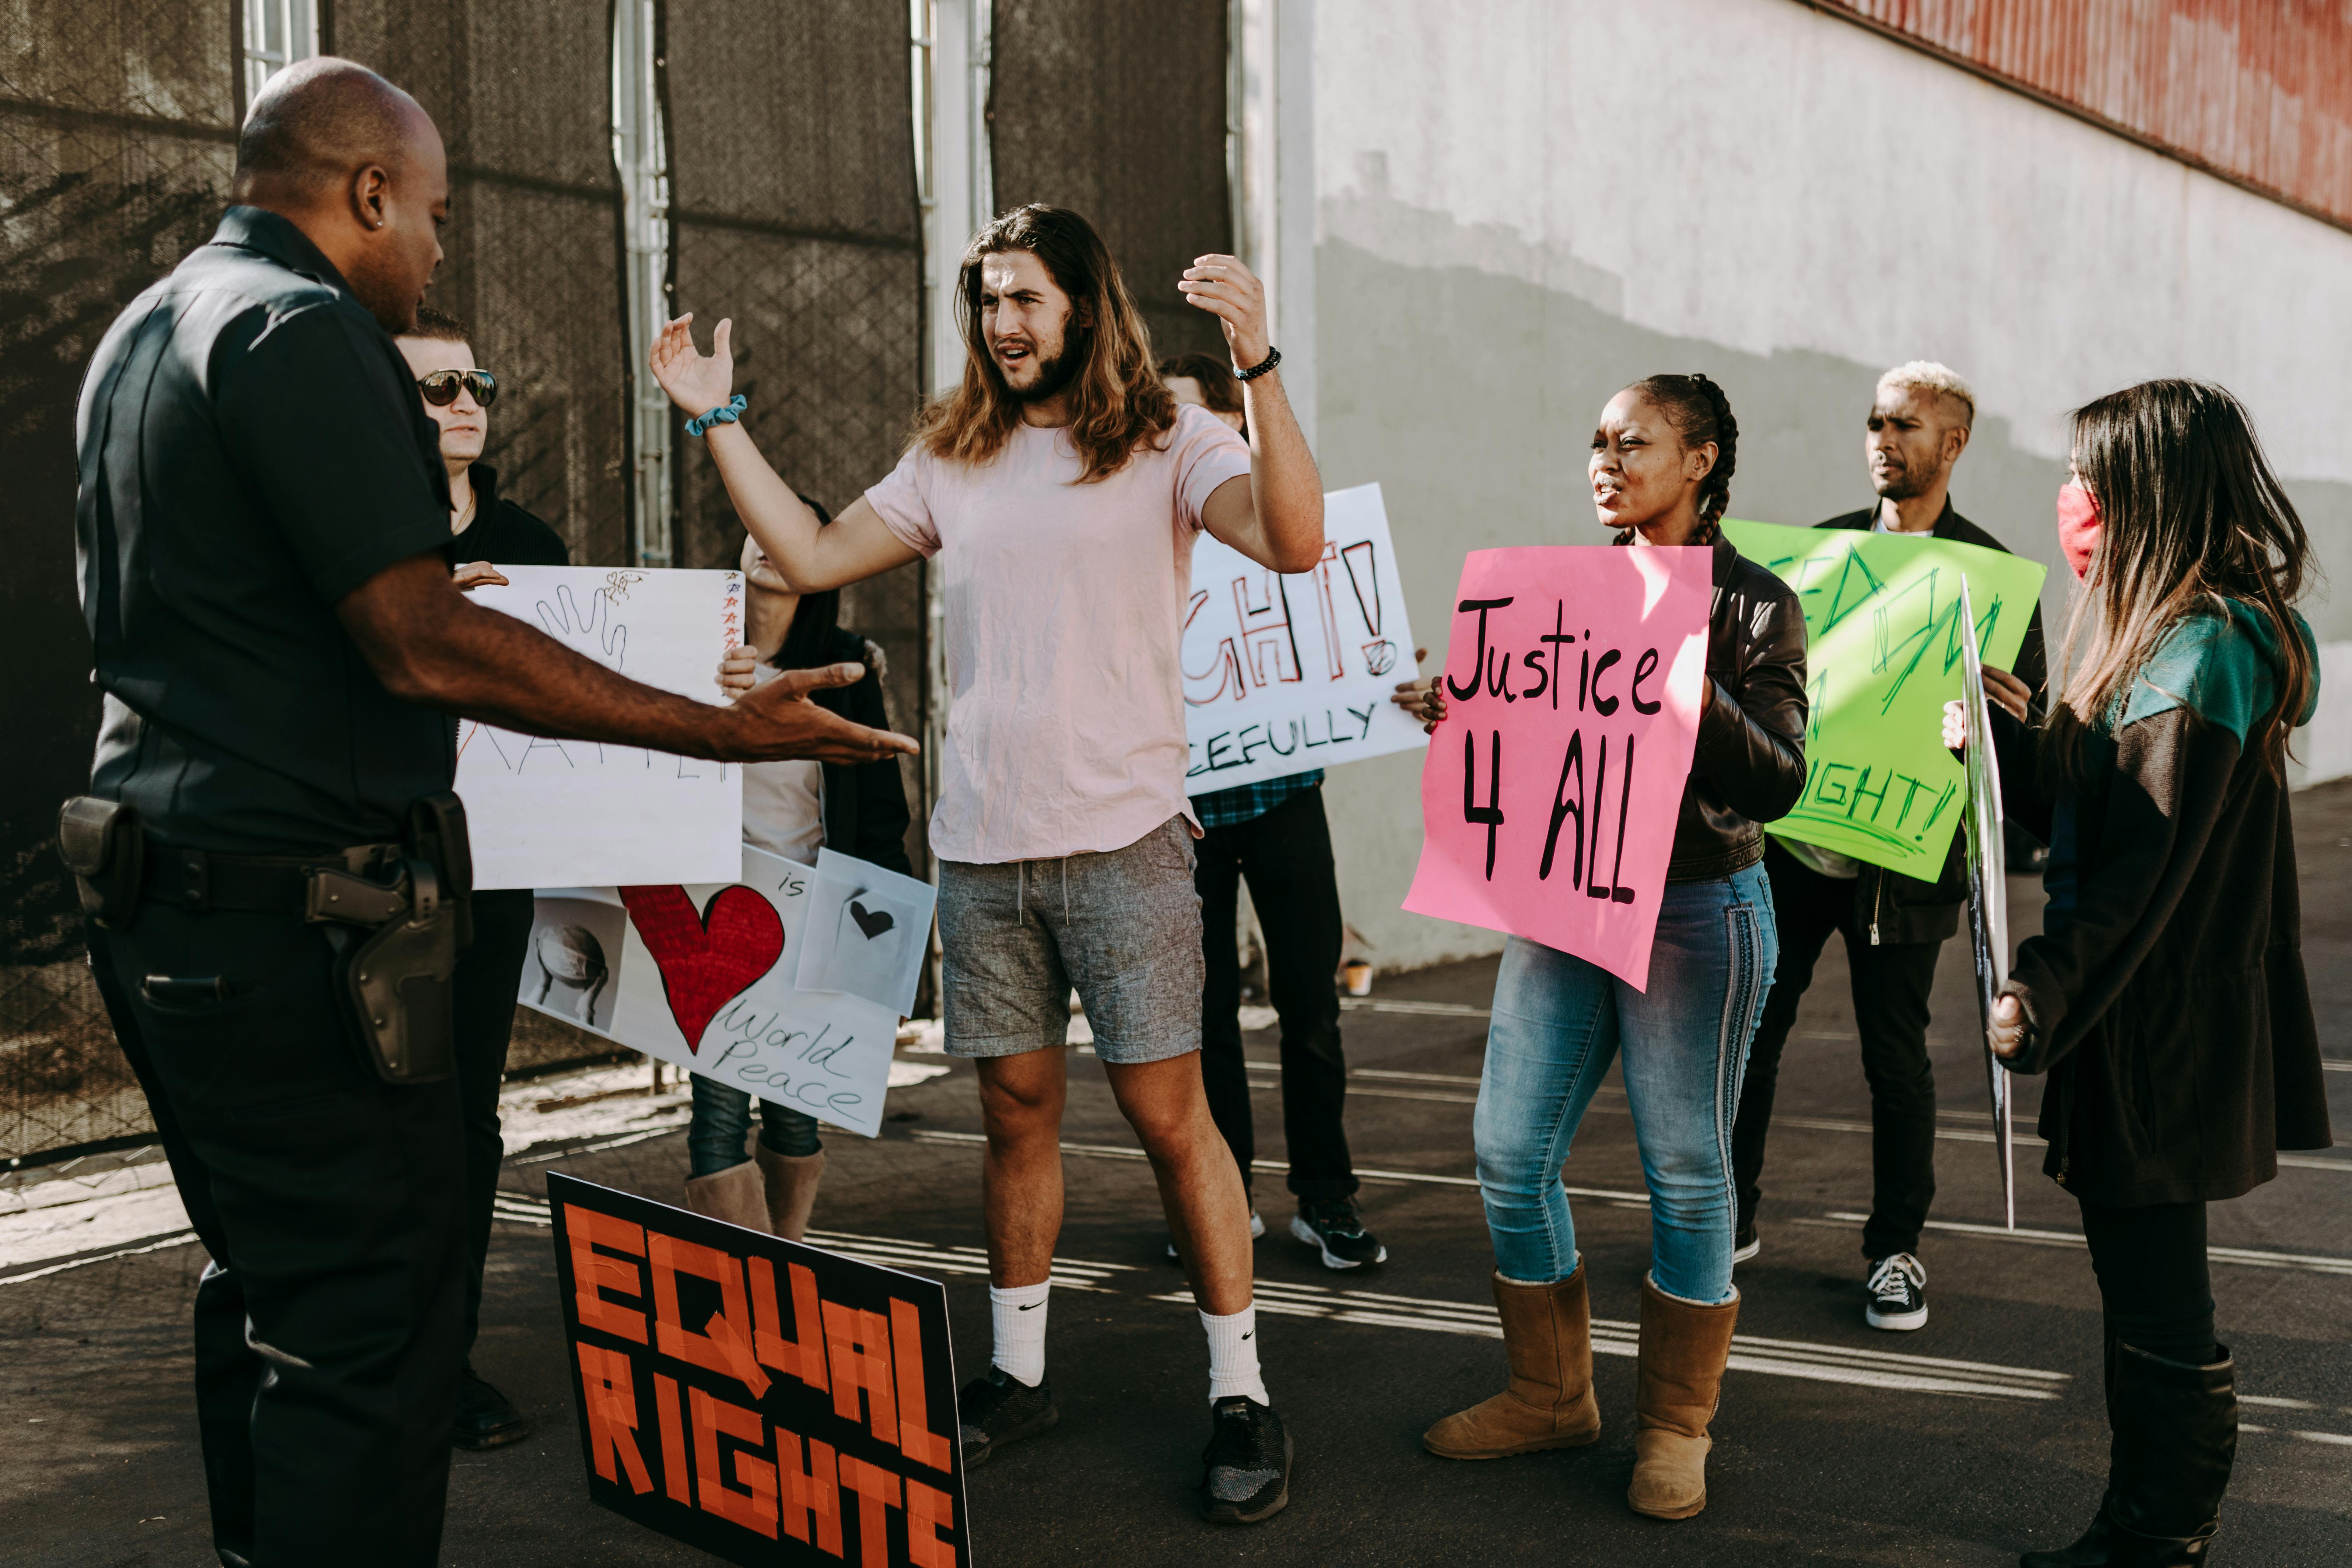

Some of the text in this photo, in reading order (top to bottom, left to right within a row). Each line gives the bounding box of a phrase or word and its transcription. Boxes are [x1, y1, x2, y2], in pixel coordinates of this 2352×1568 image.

[1447, 596, 1662, 717] Justice
[1464, 728, 1635, 905] 4 ALL
[1799, 758, 1957, 843] IGHT!
[778, 872, 806, 897] is
[712, 1039, 867, 1125] Peace
[716, 999, 854, 1079] World
[563, 1202, 952, 1474] EQUAL
